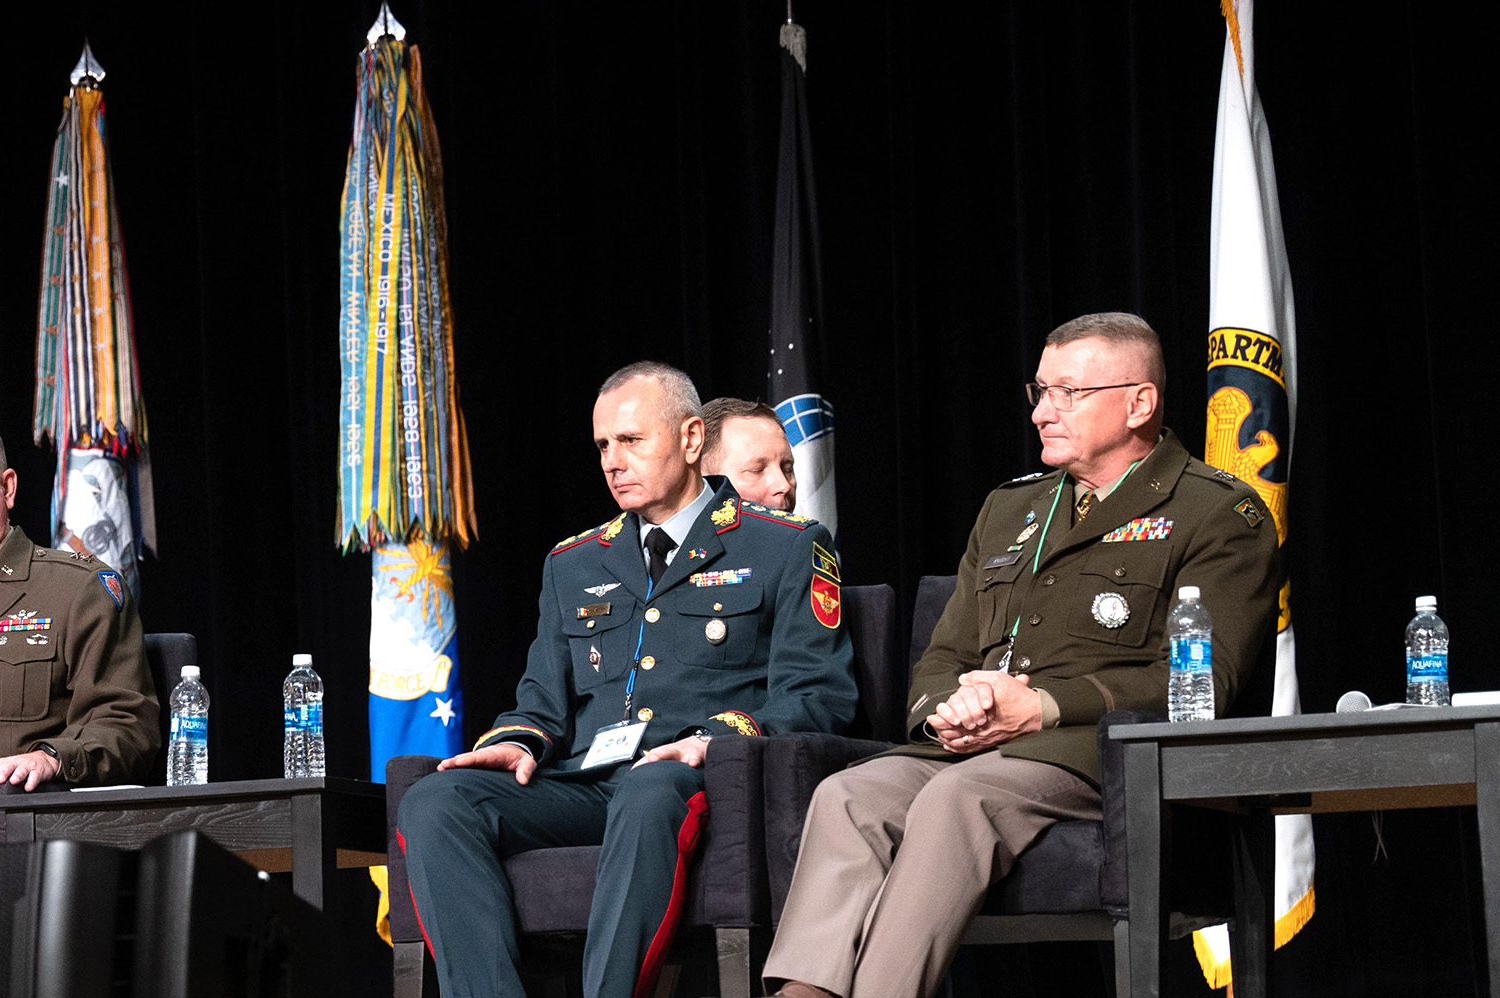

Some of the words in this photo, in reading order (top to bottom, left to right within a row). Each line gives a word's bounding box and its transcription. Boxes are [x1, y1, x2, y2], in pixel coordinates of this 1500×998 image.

[378, 193, 395, 263] MEXICO
[374, 275, 391, 355] 1916-1917
[1209, 334, 1284, 379] PARTM
[376, 671, 426, 694] FORCE
[1411, 660, 1443, 670] AQUAFINA
